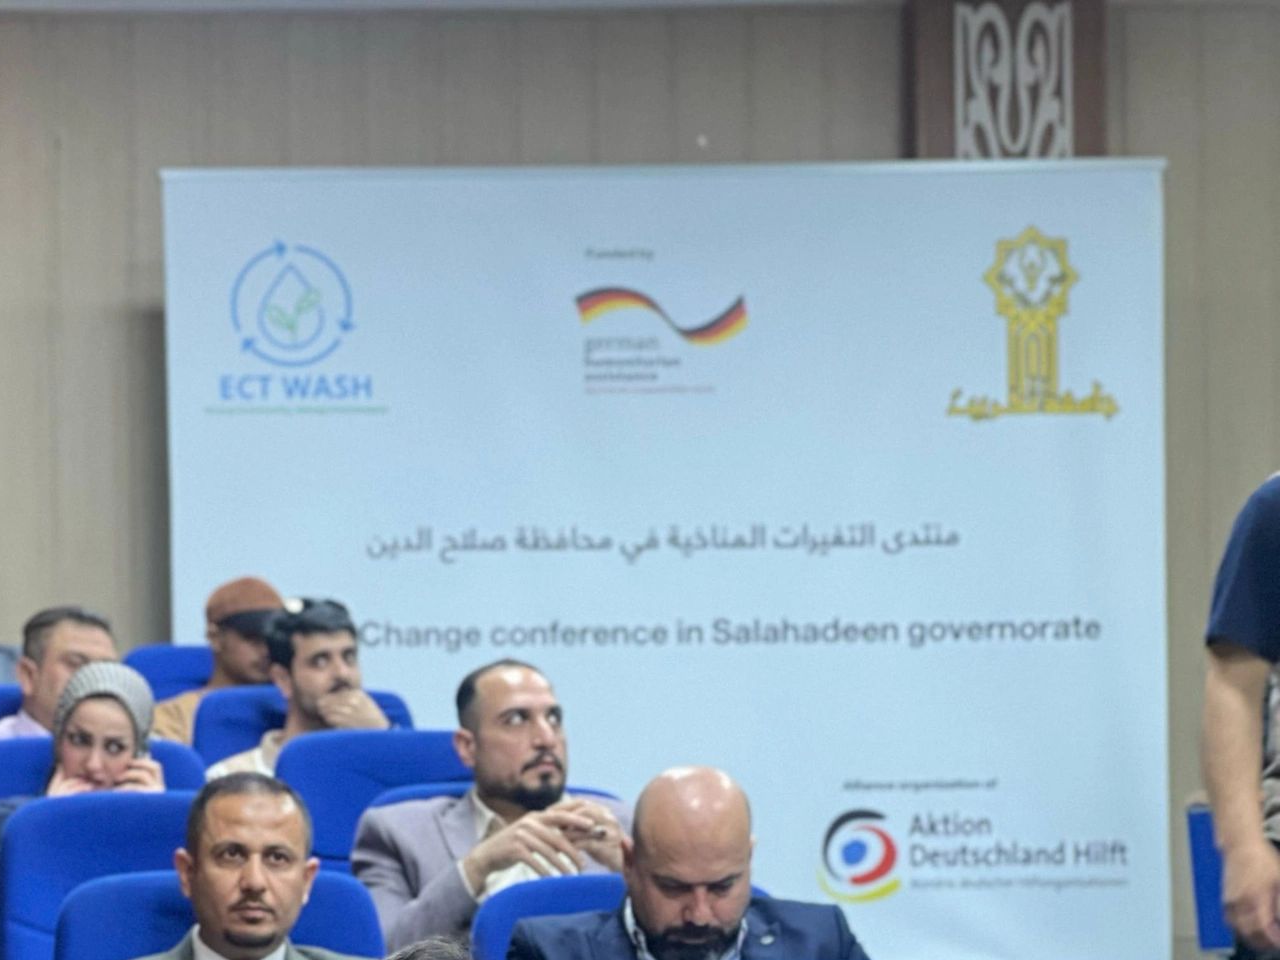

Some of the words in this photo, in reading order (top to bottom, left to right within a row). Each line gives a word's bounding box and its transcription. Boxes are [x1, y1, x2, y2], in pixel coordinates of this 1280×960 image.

[219, 374, 272, 400] ECT
[282, 374, 373, 400] WASH
[366, 526, 433, 559] الدين
[439, 527, 507, 564] صلاح
[515, 525, 613, 551] محافظة
[620, 528, 660, 564] في
[666, 523, 767, 558] المناخية
[882, 521, 960, 555] منتدى
[359, 620, 482, 652] Change
[489, 618, 668, 647] conference
[676, 617, 704, 645] in
[712, 616, 900, 645] Salahadeen
[906, 614, 1102, 648] governorate
[910, 812, 992, 836] Aktion
[910, 840, 1066, 867] Deutschland
[1073, 839, 1128, 866] Hilft
